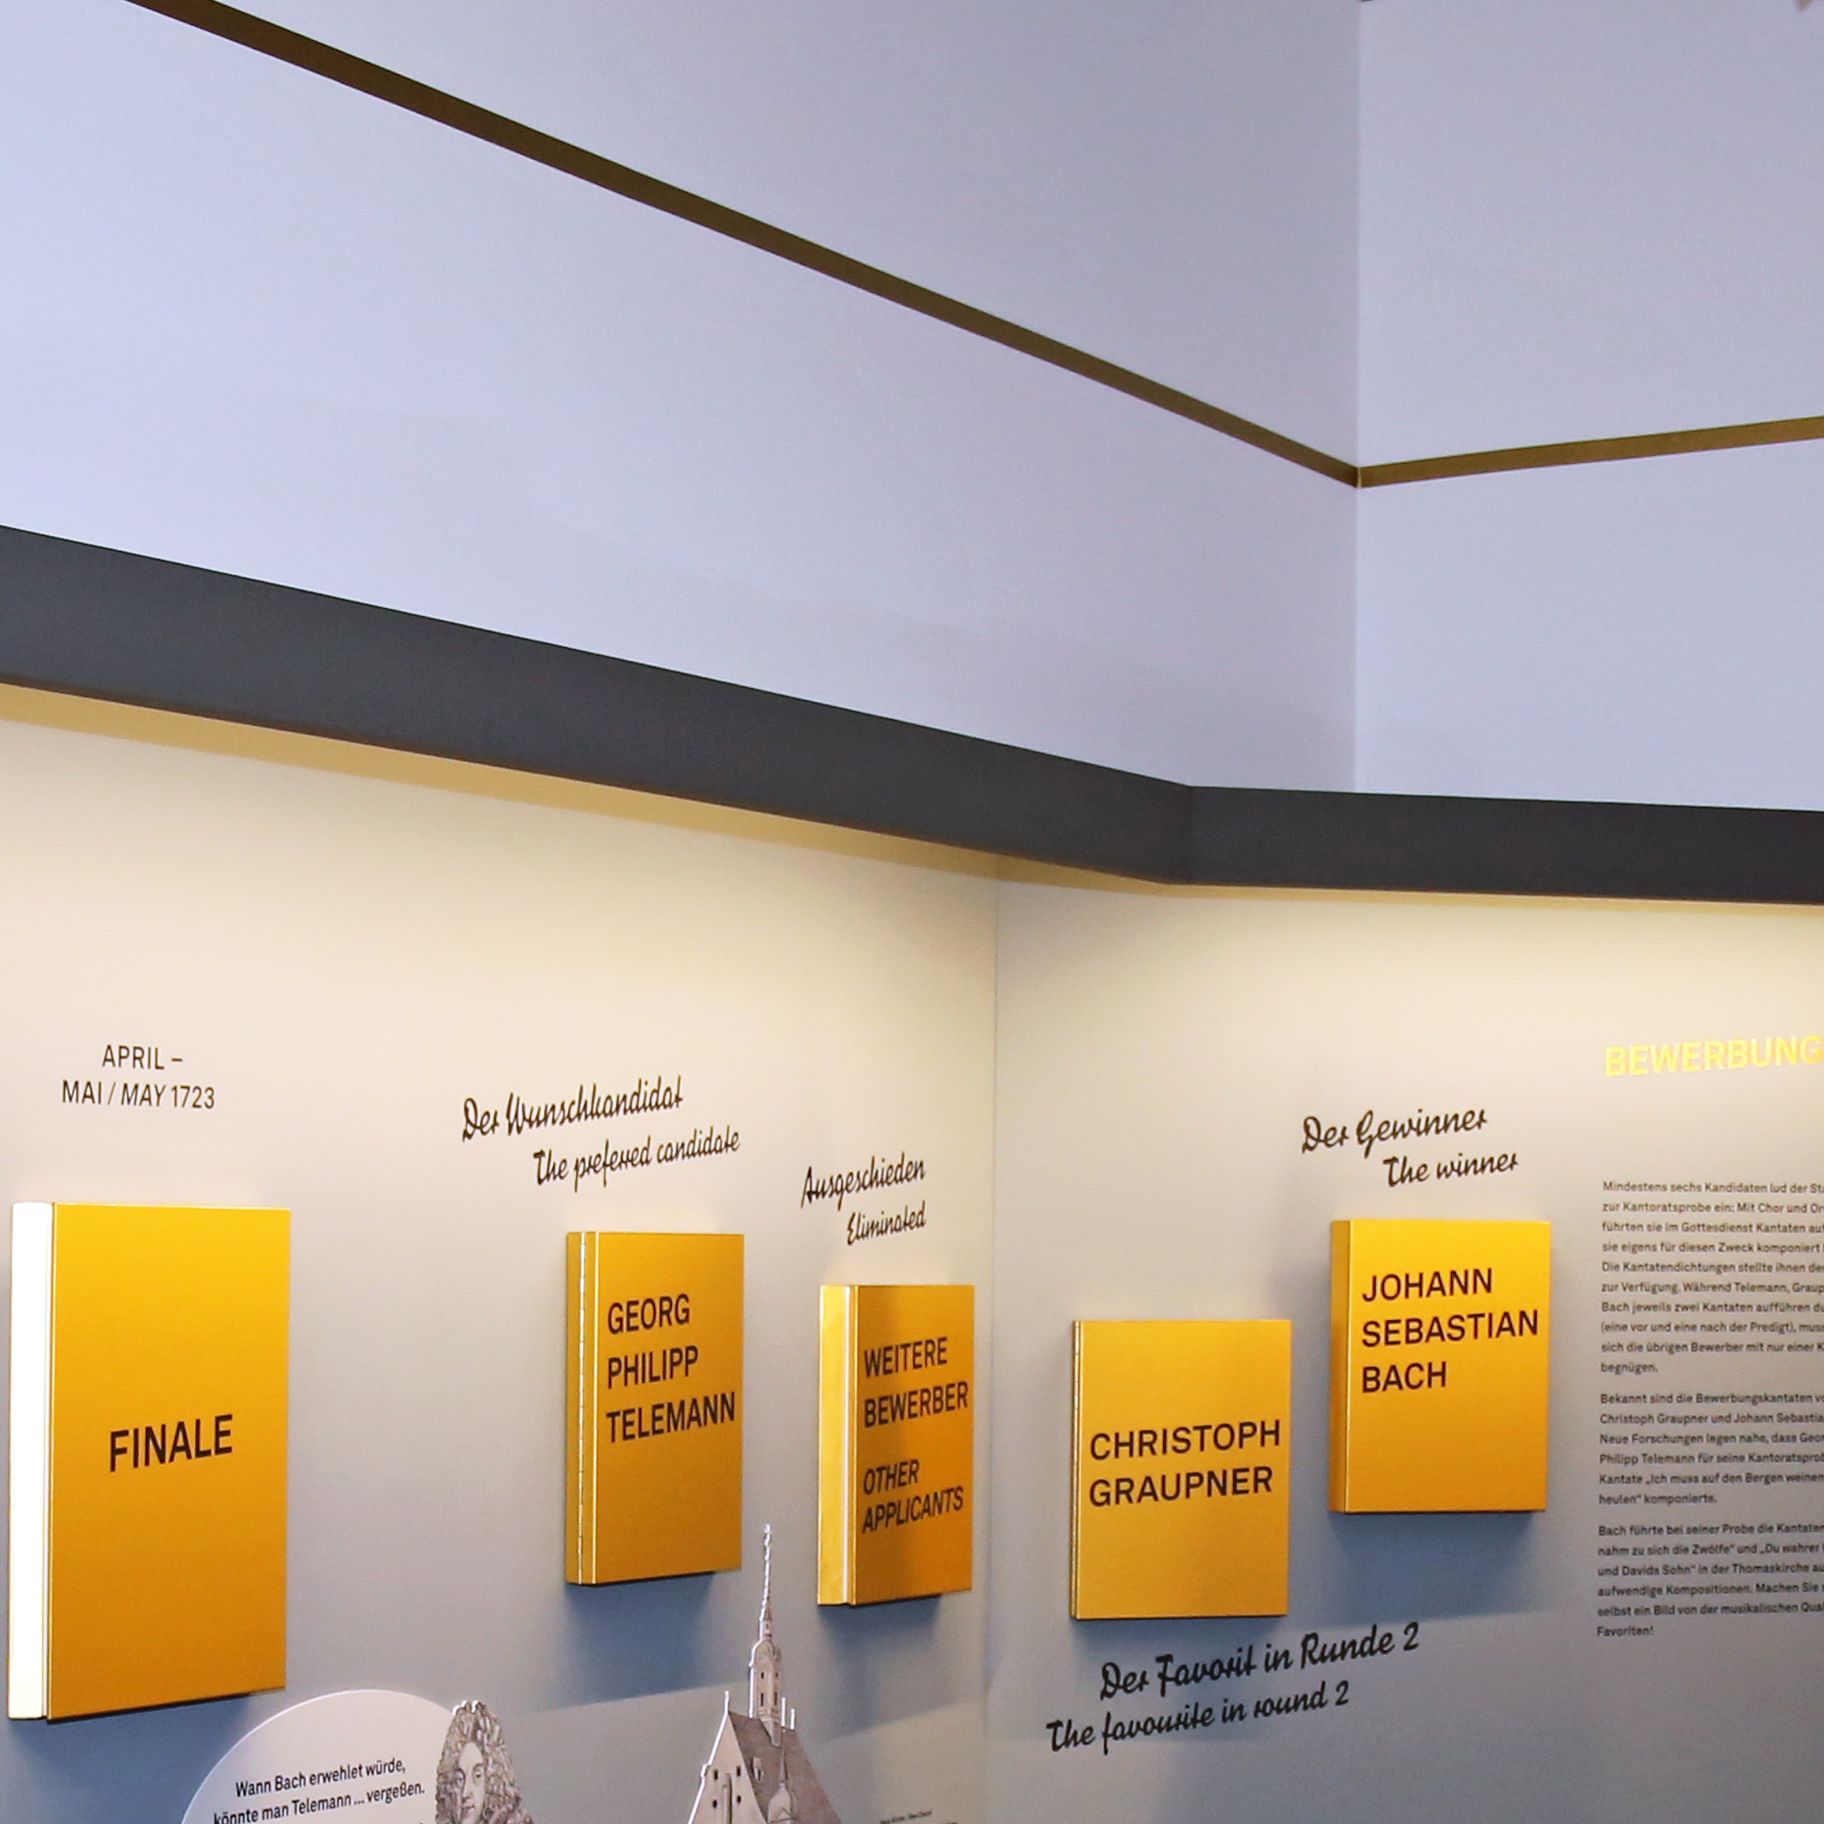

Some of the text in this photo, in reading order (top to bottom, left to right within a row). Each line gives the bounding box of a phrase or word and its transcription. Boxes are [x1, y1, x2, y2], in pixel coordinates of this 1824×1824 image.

[103, 1045, 164, 1069] APRIL
[63, 1080, 101, 1104] MAI
[121, 1083, 166, 1107] MAY
[172, 1086, 215, 1108] 1723
[463, 1075, 684, 1142] Der Wunschkandidat
[1301, 1109, 1488, 1158] Der Gewinner
[534, 1149, 568, 1186] The
[657, 1125, 740, 1163] candidate
[1384, 1150, 1519, 1187] The winner
[801, 1151, 926, 1210] Ausgeschieden
[1603, 1182, 1667, 1192] Mindestens
[1670, 1183, 1702, 1192] sechs
[1705, 1183, 1767, 1193] Kandidaten
[1770, 1183, 1787, 1193] lud
[1789, 1184, 1808, 1193] der
[847, 1201, 926, 1246] Eliminated
[1362, 1268, 1493, 1302] JOHANN
[608, 1293, 690, 1335] GEORG
[1362, 1309, 1539, 1348] SEBASTIAN
[608, 1346, 698, 1389] PHILIPP
[864, 1337, 948, 1378] WEITERE
[1362, 1361, 1447, 1393] BACH
[607, 1392, 735, 1443] TELEMANN
[864, 1382, 968, 1428] BEWERBER
[109, 1414, 233, 1472] FINALE
[1090, 1420, 1280, 1461] CHRISTOPH
[863, 1459, 920, 1494] OTHER
[1089, 1466, 1273, 1507] GRAUPNER
[862, 1486, 964, 1534] APPLICANTS
[1100, 1622, 1420, 1700] Der Favorit in Runde 2
[1046, 1680, 1350, 1755] The favourite in round 2
[236, 1758, 405, 1798] Wann Bach erwehlet würde,
[259, 1804, 289, 1822] man
[292, 1793, 352, 1818] Telemann
[367, 1780, 425, 1805] vergeßen.
